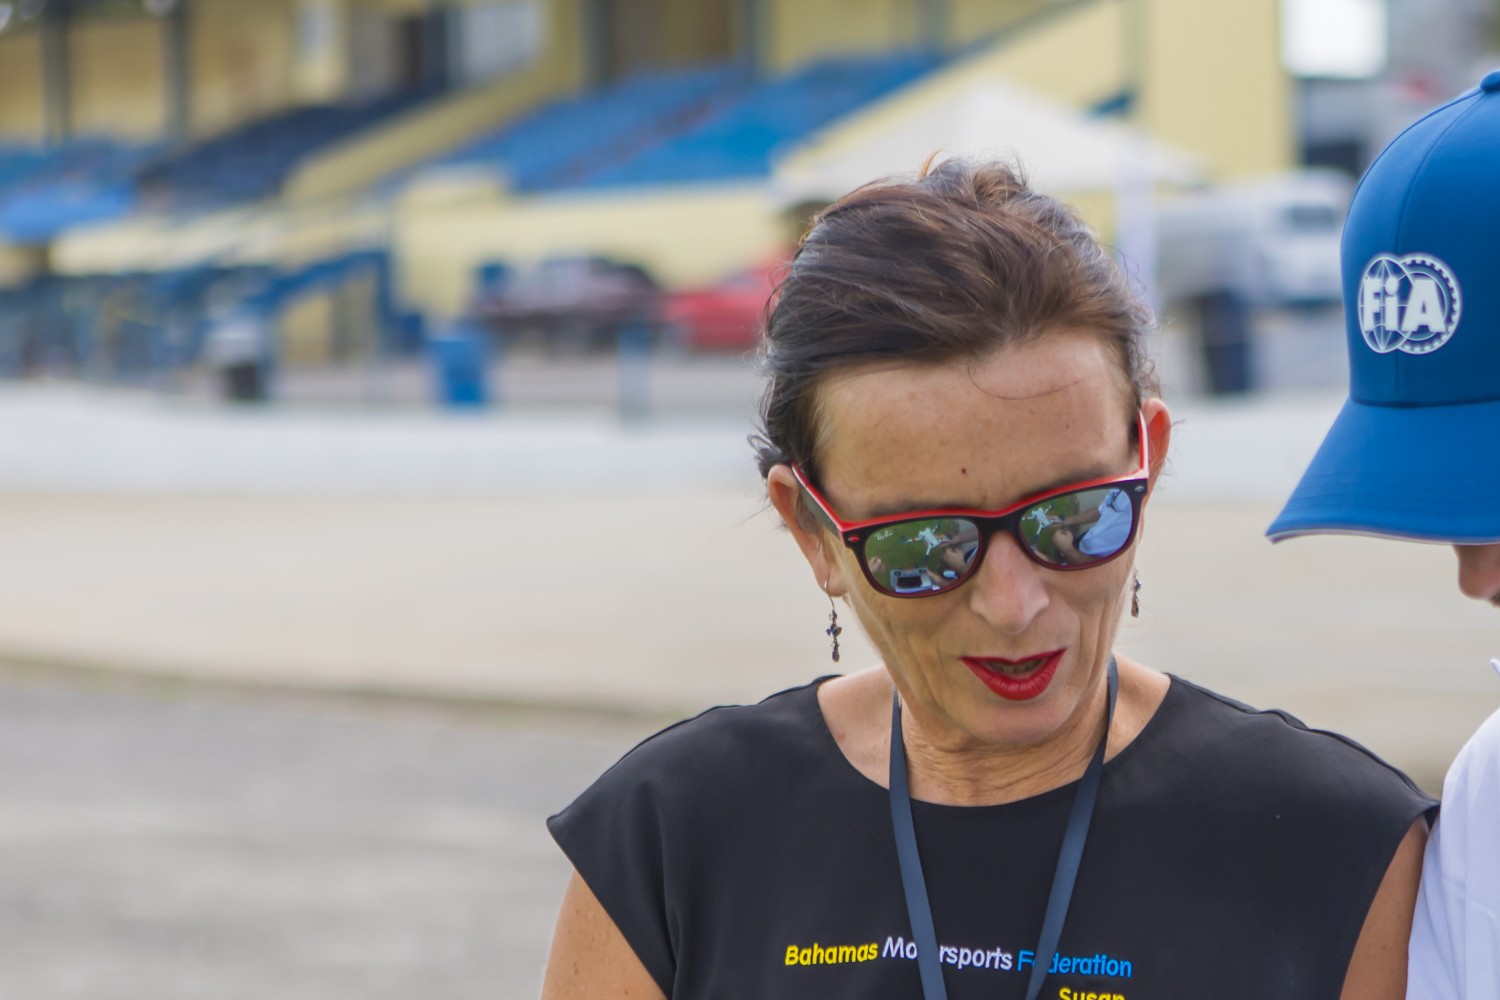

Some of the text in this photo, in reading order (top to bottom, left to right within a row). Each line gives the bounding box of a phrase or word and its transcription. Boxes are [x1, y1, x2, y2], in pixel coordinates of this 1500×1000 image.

[784, 936, 1133, 978] Bahamas Morsports Fderation
